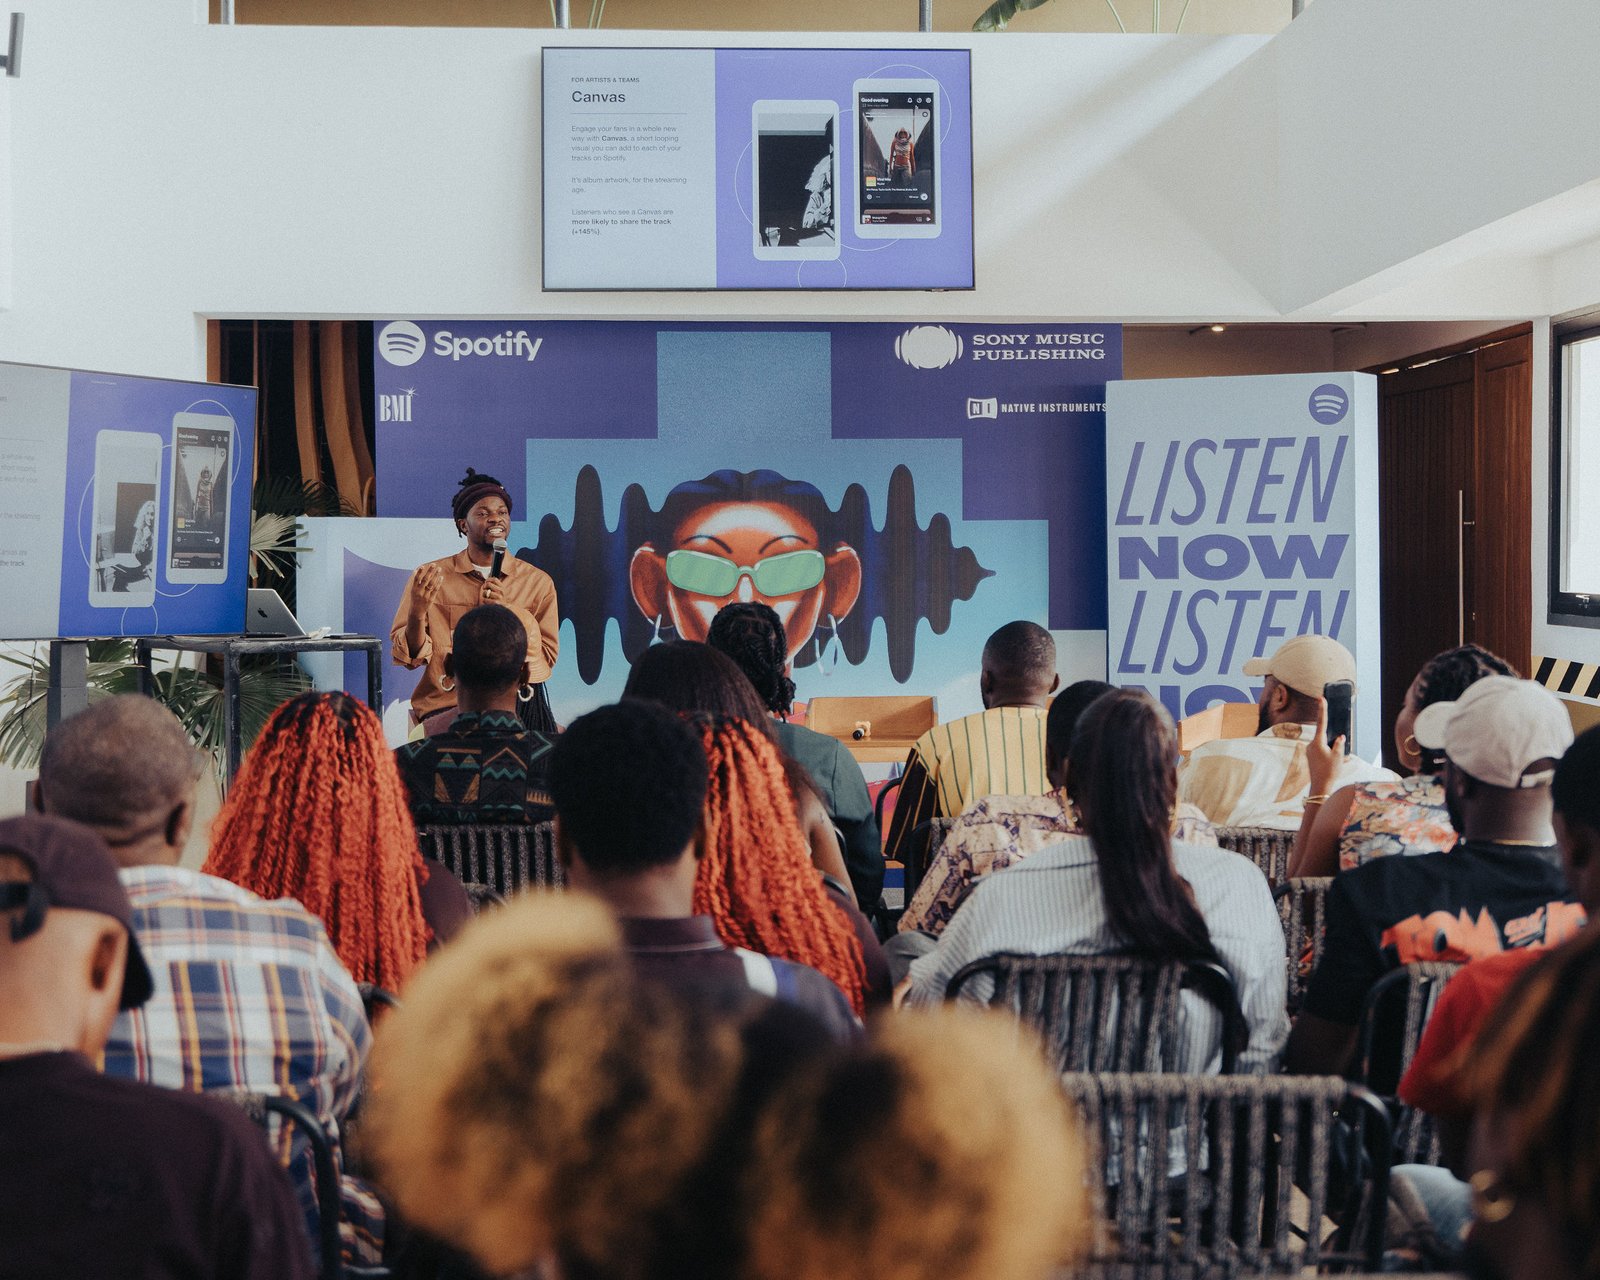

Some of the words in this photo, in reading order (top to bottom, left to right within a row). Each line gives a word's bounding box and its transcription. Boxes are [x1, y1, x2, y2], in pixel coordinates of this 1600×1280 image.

[572, 91, 626, 103] Canvas
[434, 331, 543, 361] Spotify
[973, 335, 1030, 345] SONY
[1036, 334, 1104, 345] MUSIC
[973, 349, 1106, 360] PUBLISHING
[380, 393, 412, 421] BMI
[1002, 403, 1035, 412] NATIVE
[1039, 403, 1106, 412] INSTRUMENTS
[1115, 435, 1349, 526] LISTEN
[1118, 534, 1349, 580] NOW
